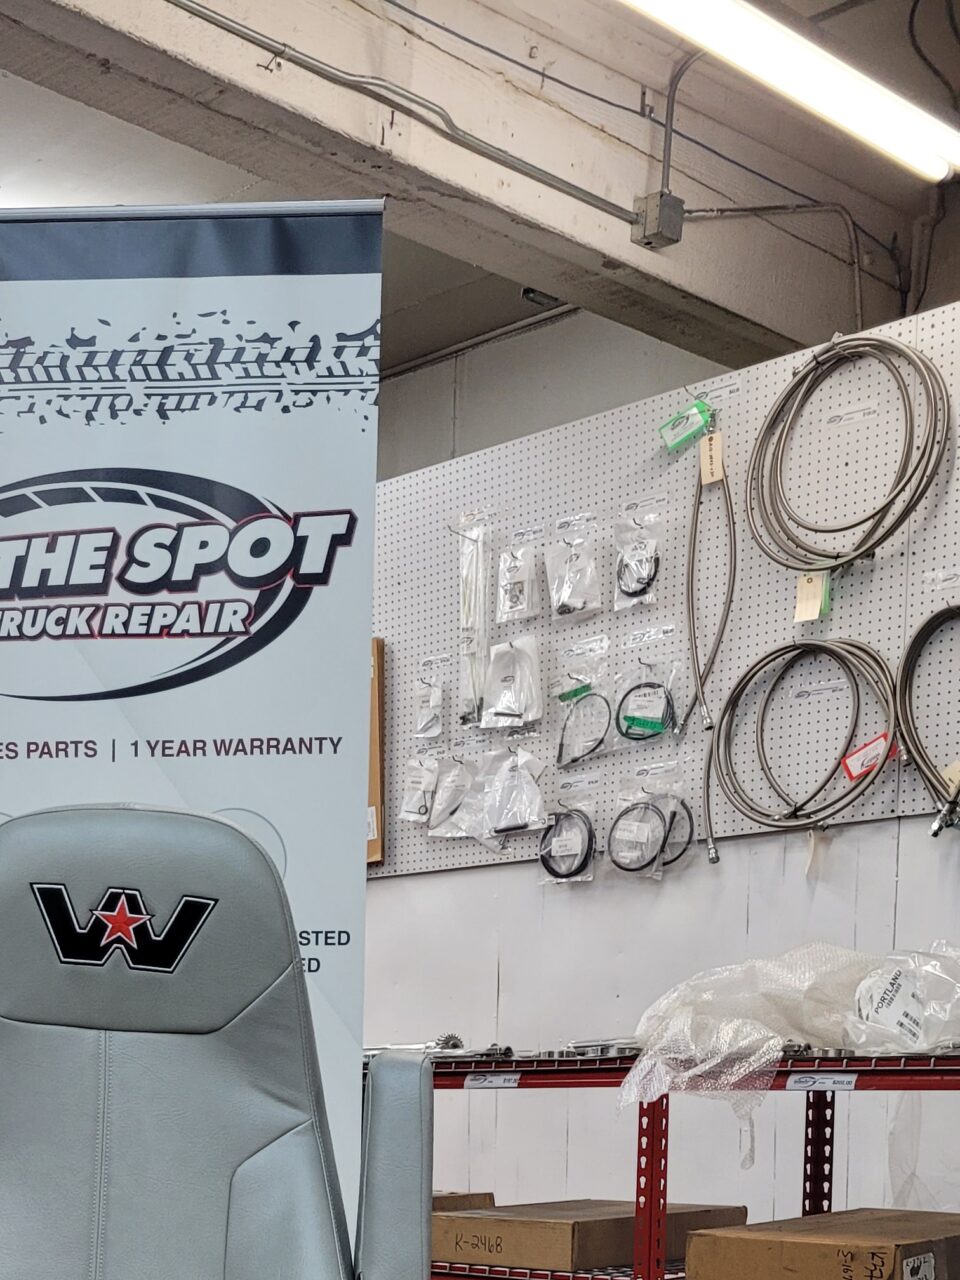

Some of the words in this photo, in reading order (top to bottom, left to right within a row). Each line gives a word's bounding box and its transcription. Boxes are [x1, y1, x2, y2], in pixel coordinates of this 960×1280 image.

[118, 509, 358, 594] SPOT
[94, 599, 255, 638] REPAIR
[26, 739, 98, 759] PARTS
[131, 739, 139, 758] 1
[145, 739, 207, 758] YEAR
[213, 736, 343, 757] WARRANTY
[874, 969, 903, 1015] PORTLAND
[454, 1233, 503, 1254] K-2468
